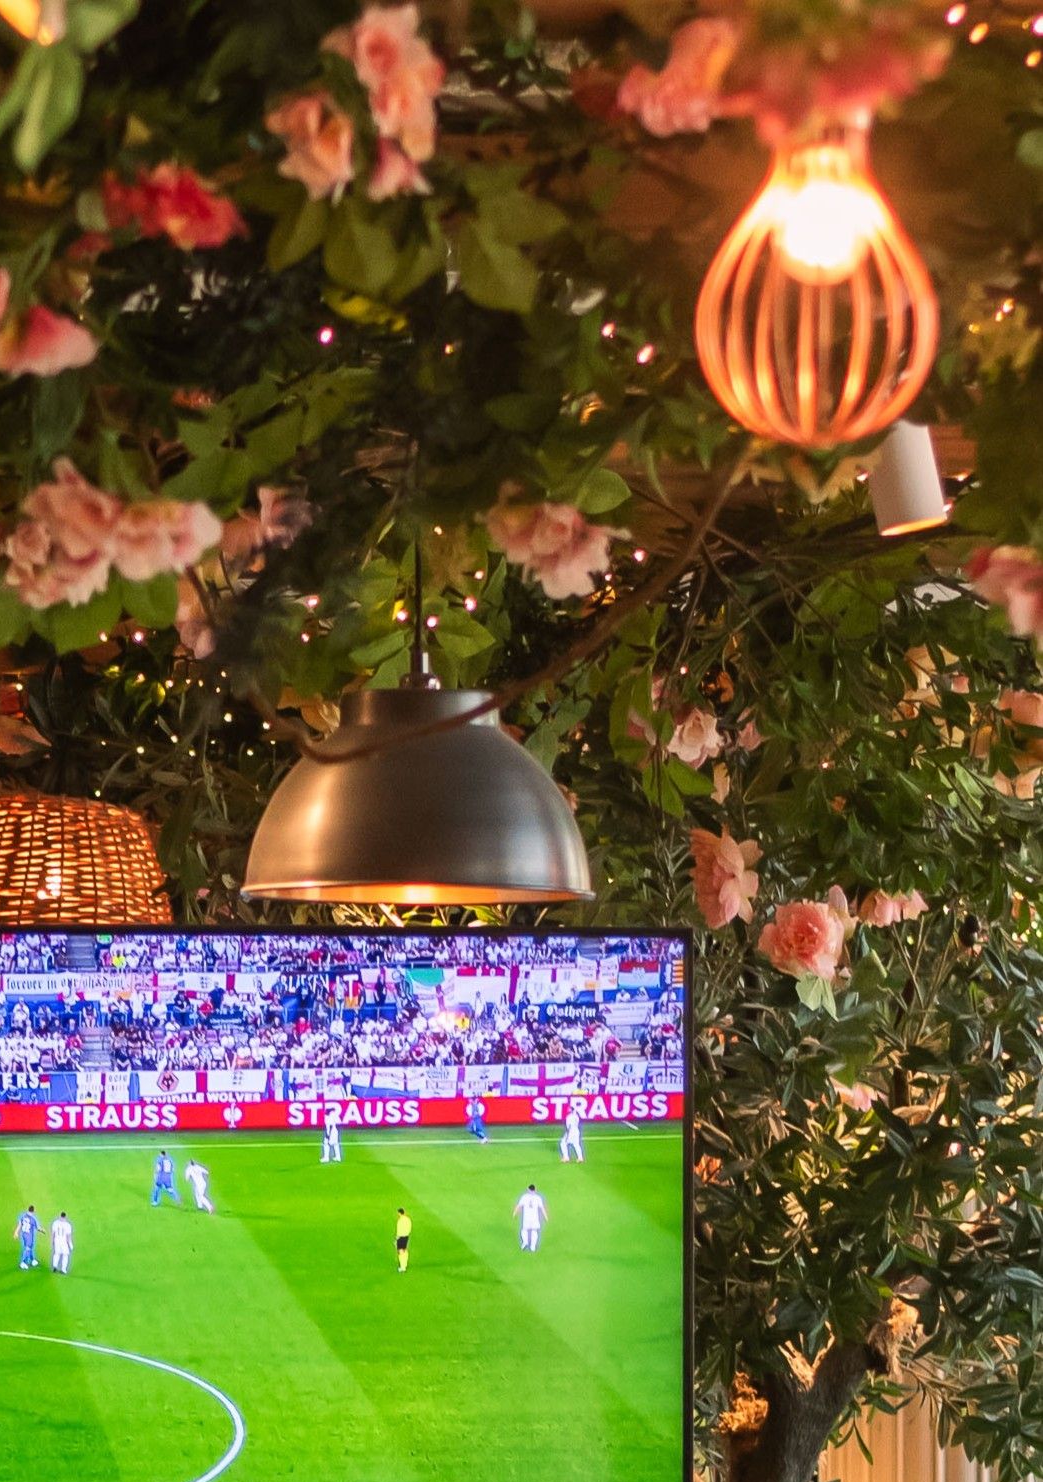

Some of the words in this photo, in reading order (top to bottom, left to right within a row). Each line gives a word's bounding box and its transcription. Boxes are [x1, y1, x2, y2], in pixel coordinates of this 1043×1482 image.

[46, 1104, 178, 1128] STRAUSS
[288, 1100, 420, 1125] STRAUSS
[531, 1095, 668, 1120] STRAUSS
